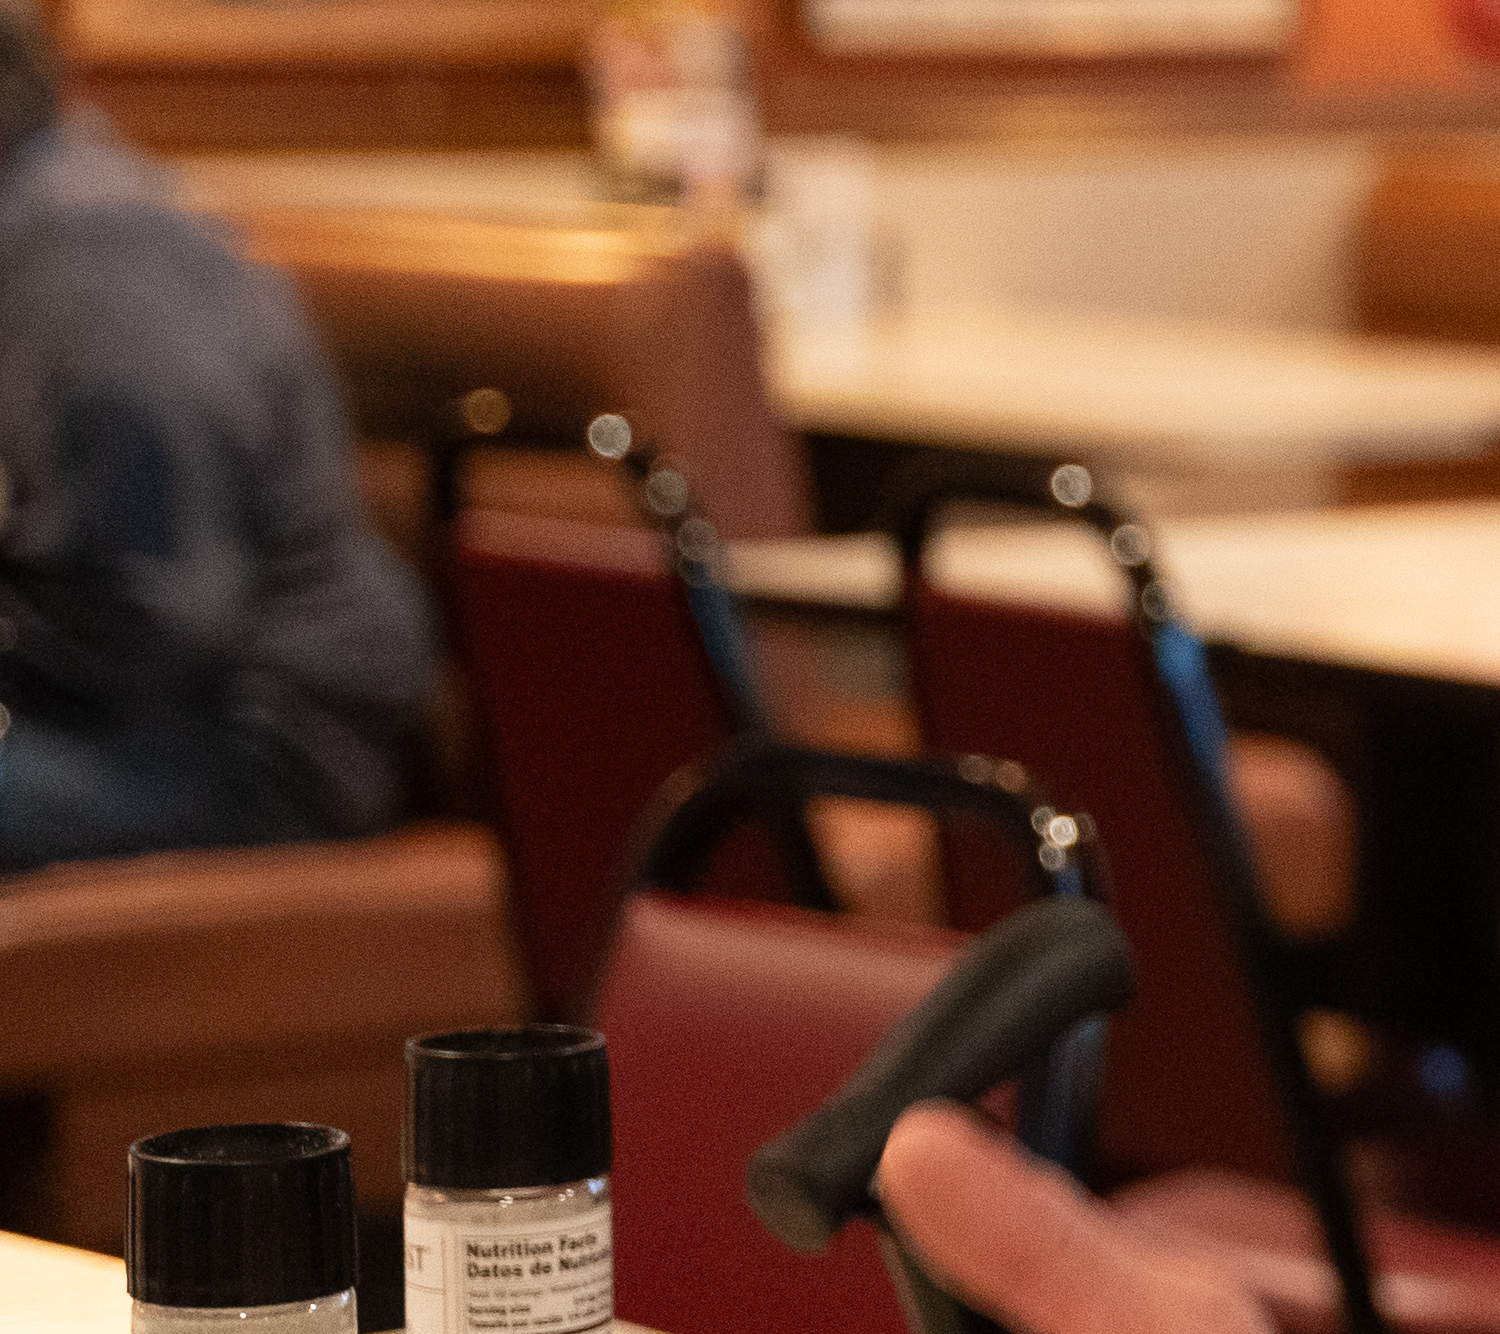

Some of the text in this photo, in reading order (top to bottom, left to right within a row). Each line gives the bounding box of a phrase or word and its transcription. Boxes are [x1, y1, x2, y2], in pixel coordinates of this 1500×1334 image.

[467, 1240, 553, 1259] Nutrition
[467, 1262, 523, 1278] Datos
[529, 1262, 552, 1276] de
